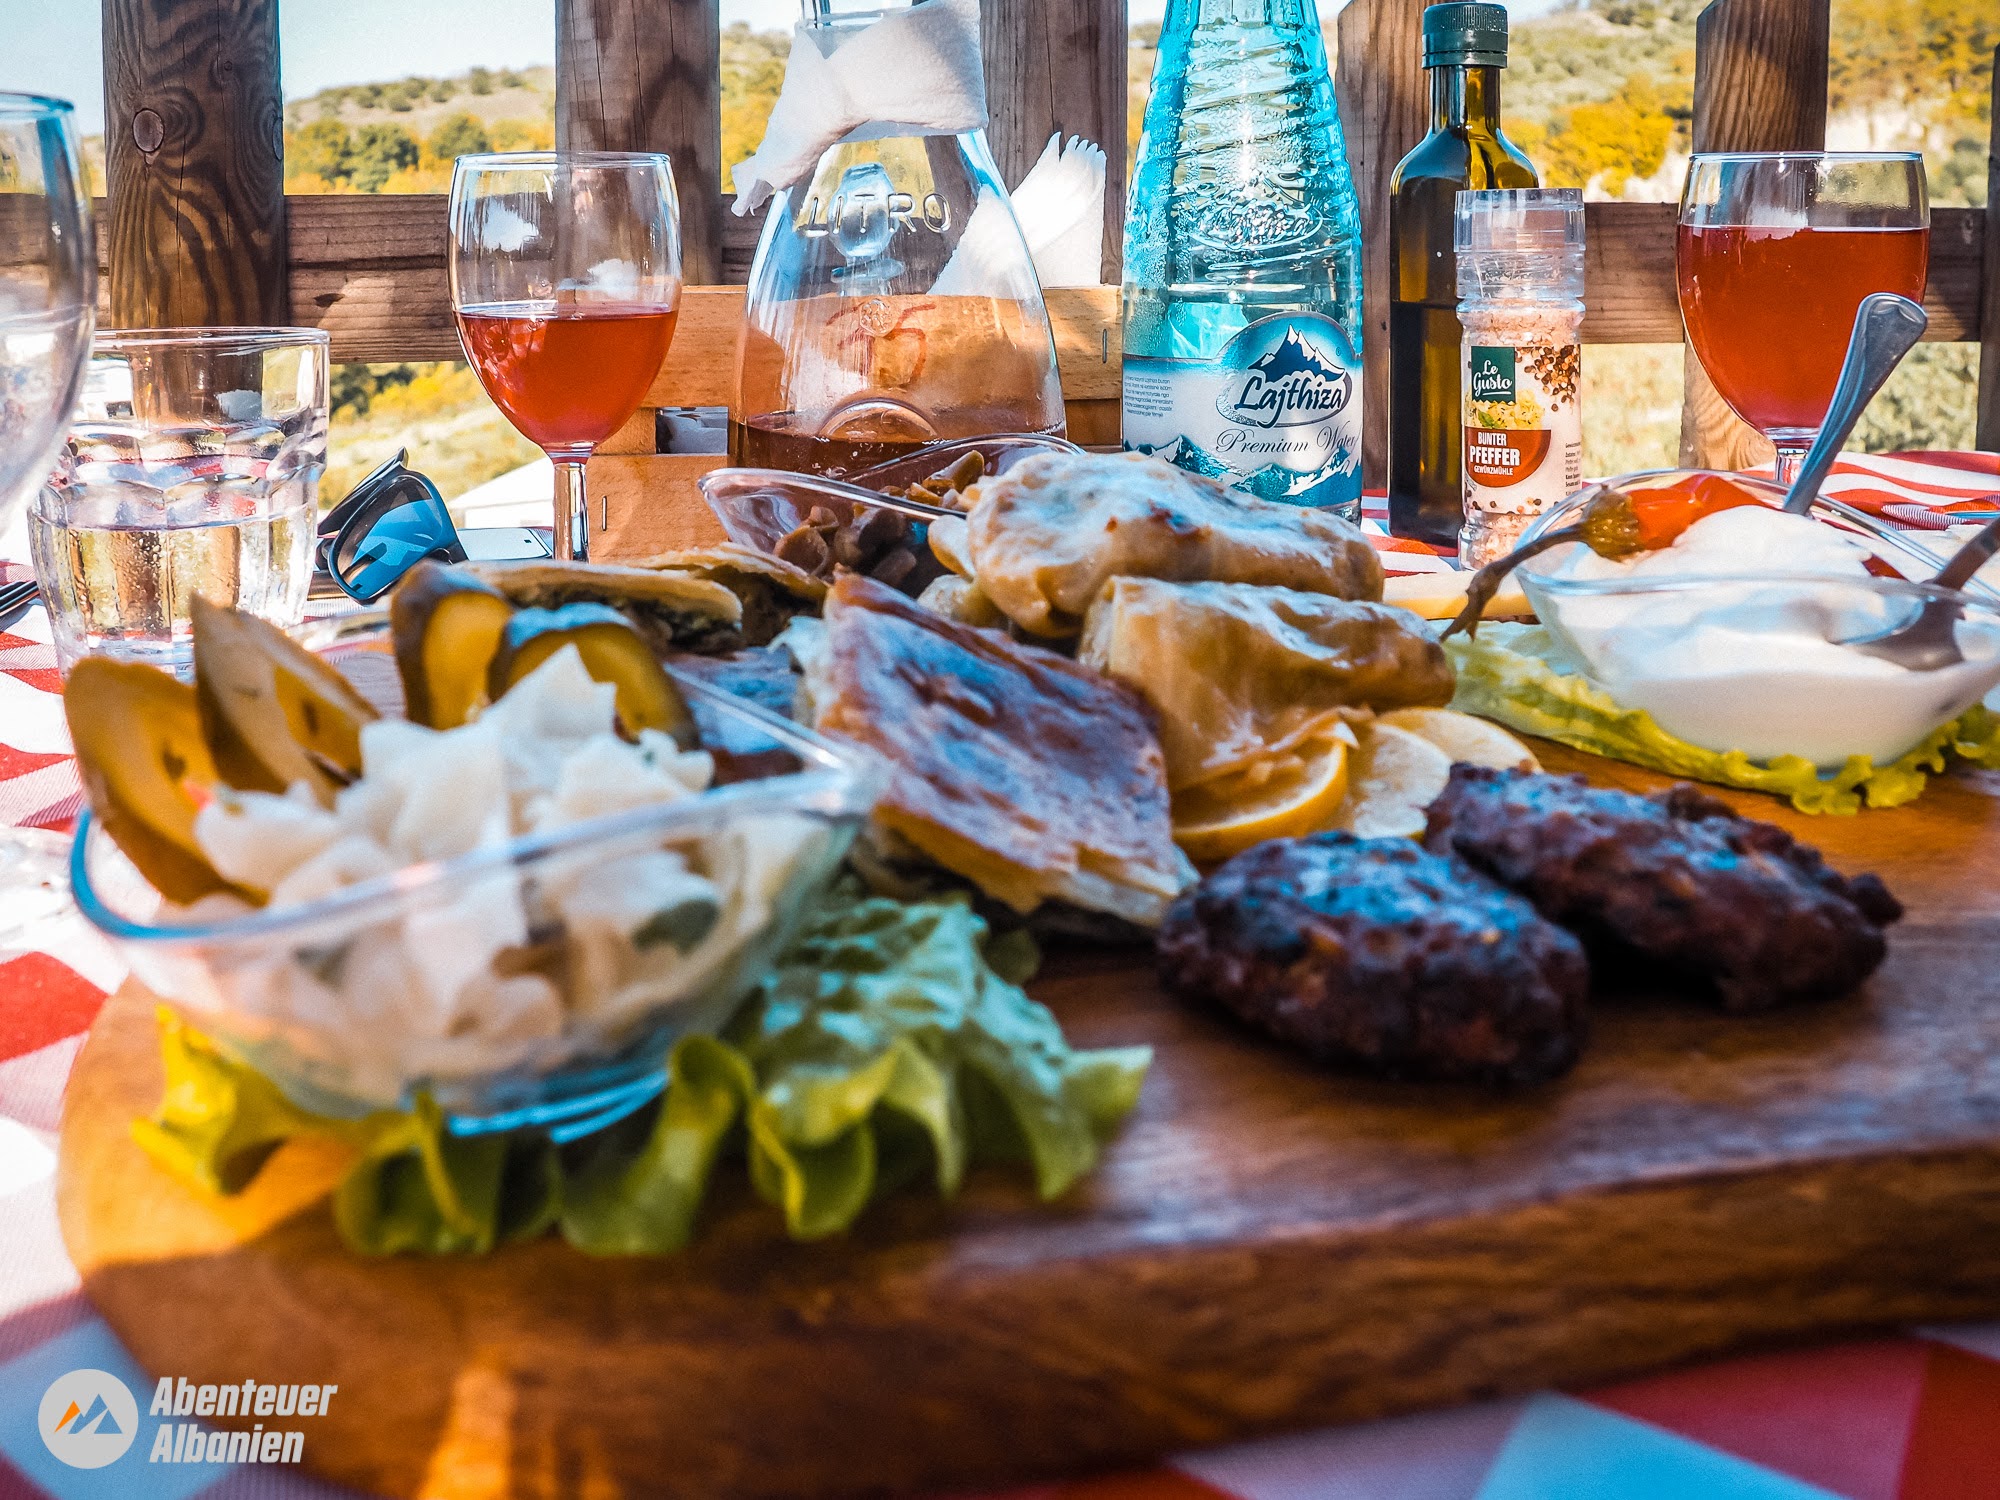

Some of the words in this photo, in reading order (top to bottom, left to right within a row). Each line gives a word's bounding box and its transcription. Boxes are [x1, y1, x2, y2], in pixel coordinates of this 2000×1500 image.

[802, 193, 951, 236] LITRO
[1482, 360, 1498, 375] Le
[1473, 372, 1513, 397] Gusto
[1234, 376, 1342, 428] Lajthiza
[1216, 428, 1310, 453] Premium
[1478, 432, 1507, 446] BUNTER
[1470, 446, 1520, 466] PFEFFER
[1474, 465, 1513, 475] GEWÜRZMÜHLE
